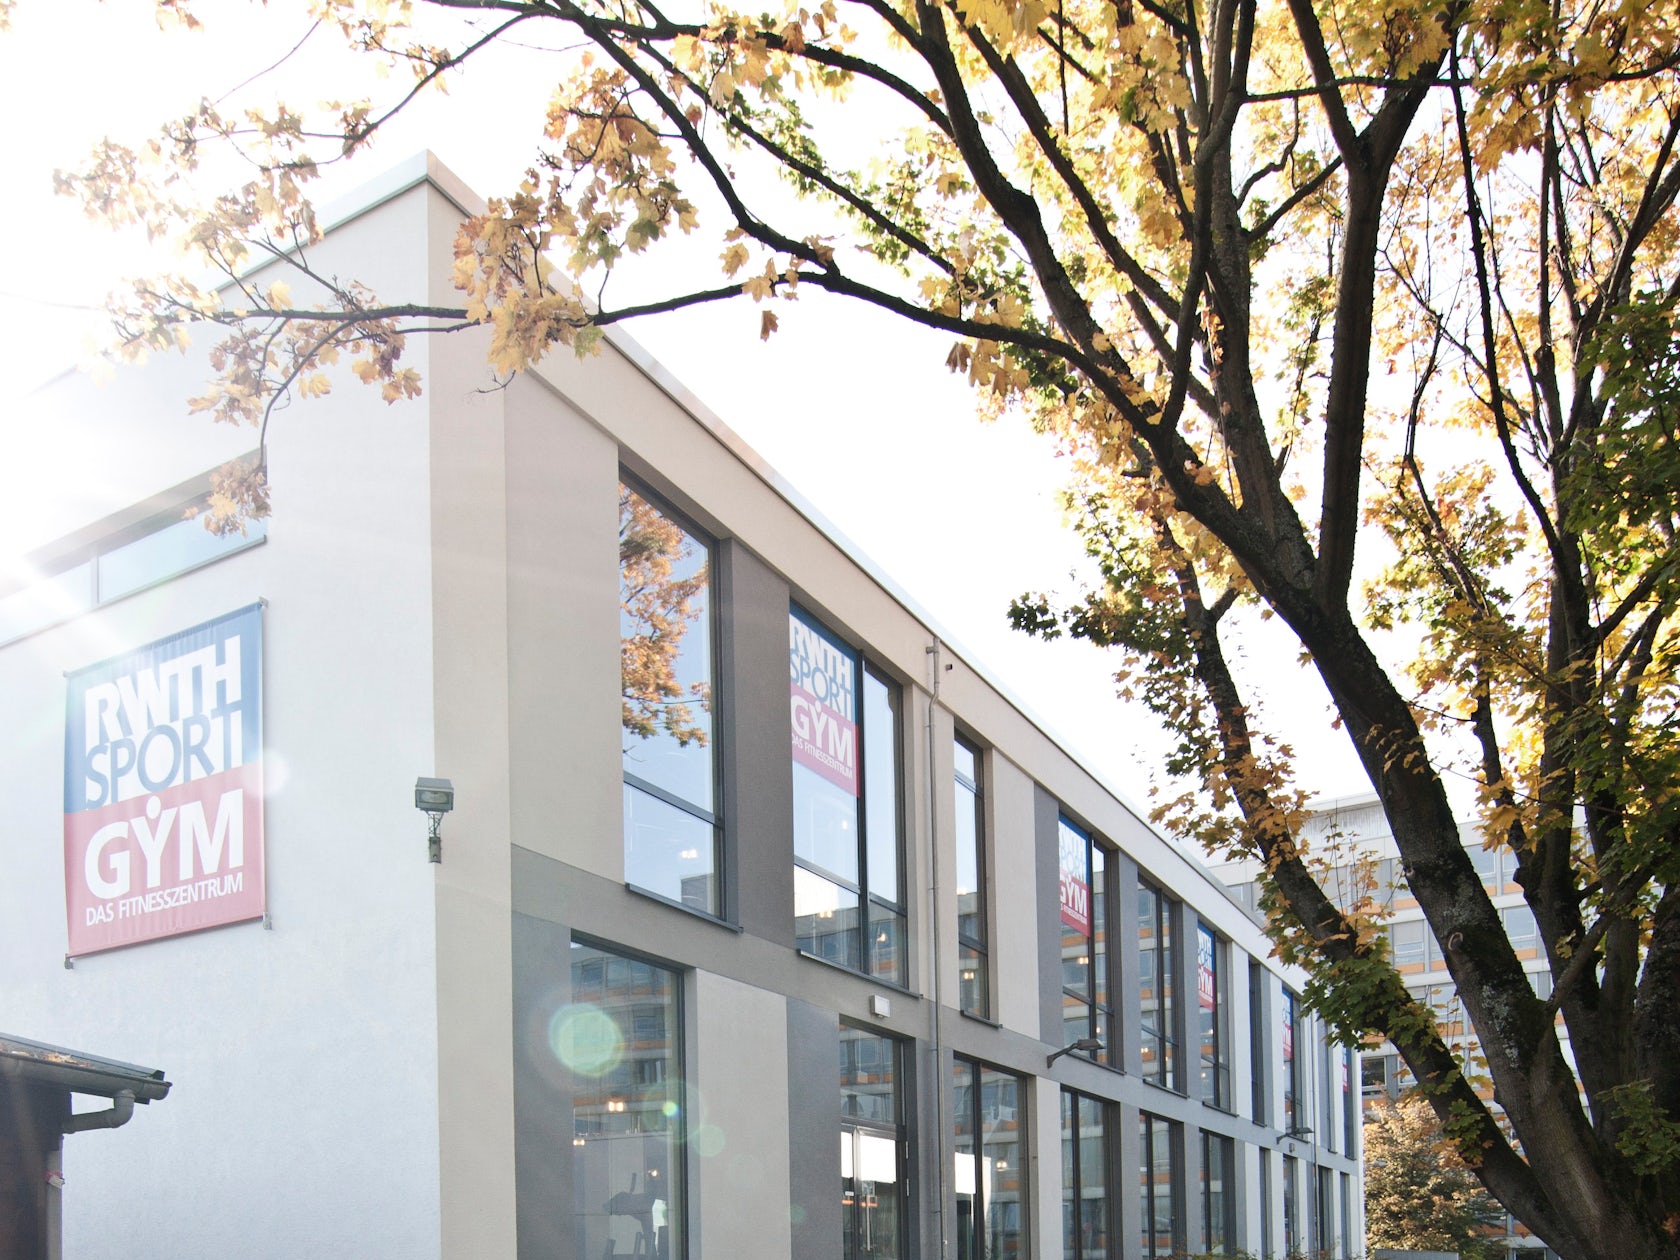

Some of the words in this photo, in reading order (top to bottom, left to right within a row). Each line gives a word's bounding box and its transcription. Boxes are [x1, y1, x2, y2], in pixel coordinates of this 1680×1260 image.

[790, 614, 850, 690] RWTH
[790, 649, 850, 718] SPORT
[85, 634, 241, 747] RWTH
[85, 703, 243, 810] SPORT
[791, 695, 852, 768] GYM
[85, 795, 244, 899] GYM
[86, 902, 114, 926] DAS
[118, 872, 244, 919] FITNESSZENTRUM
